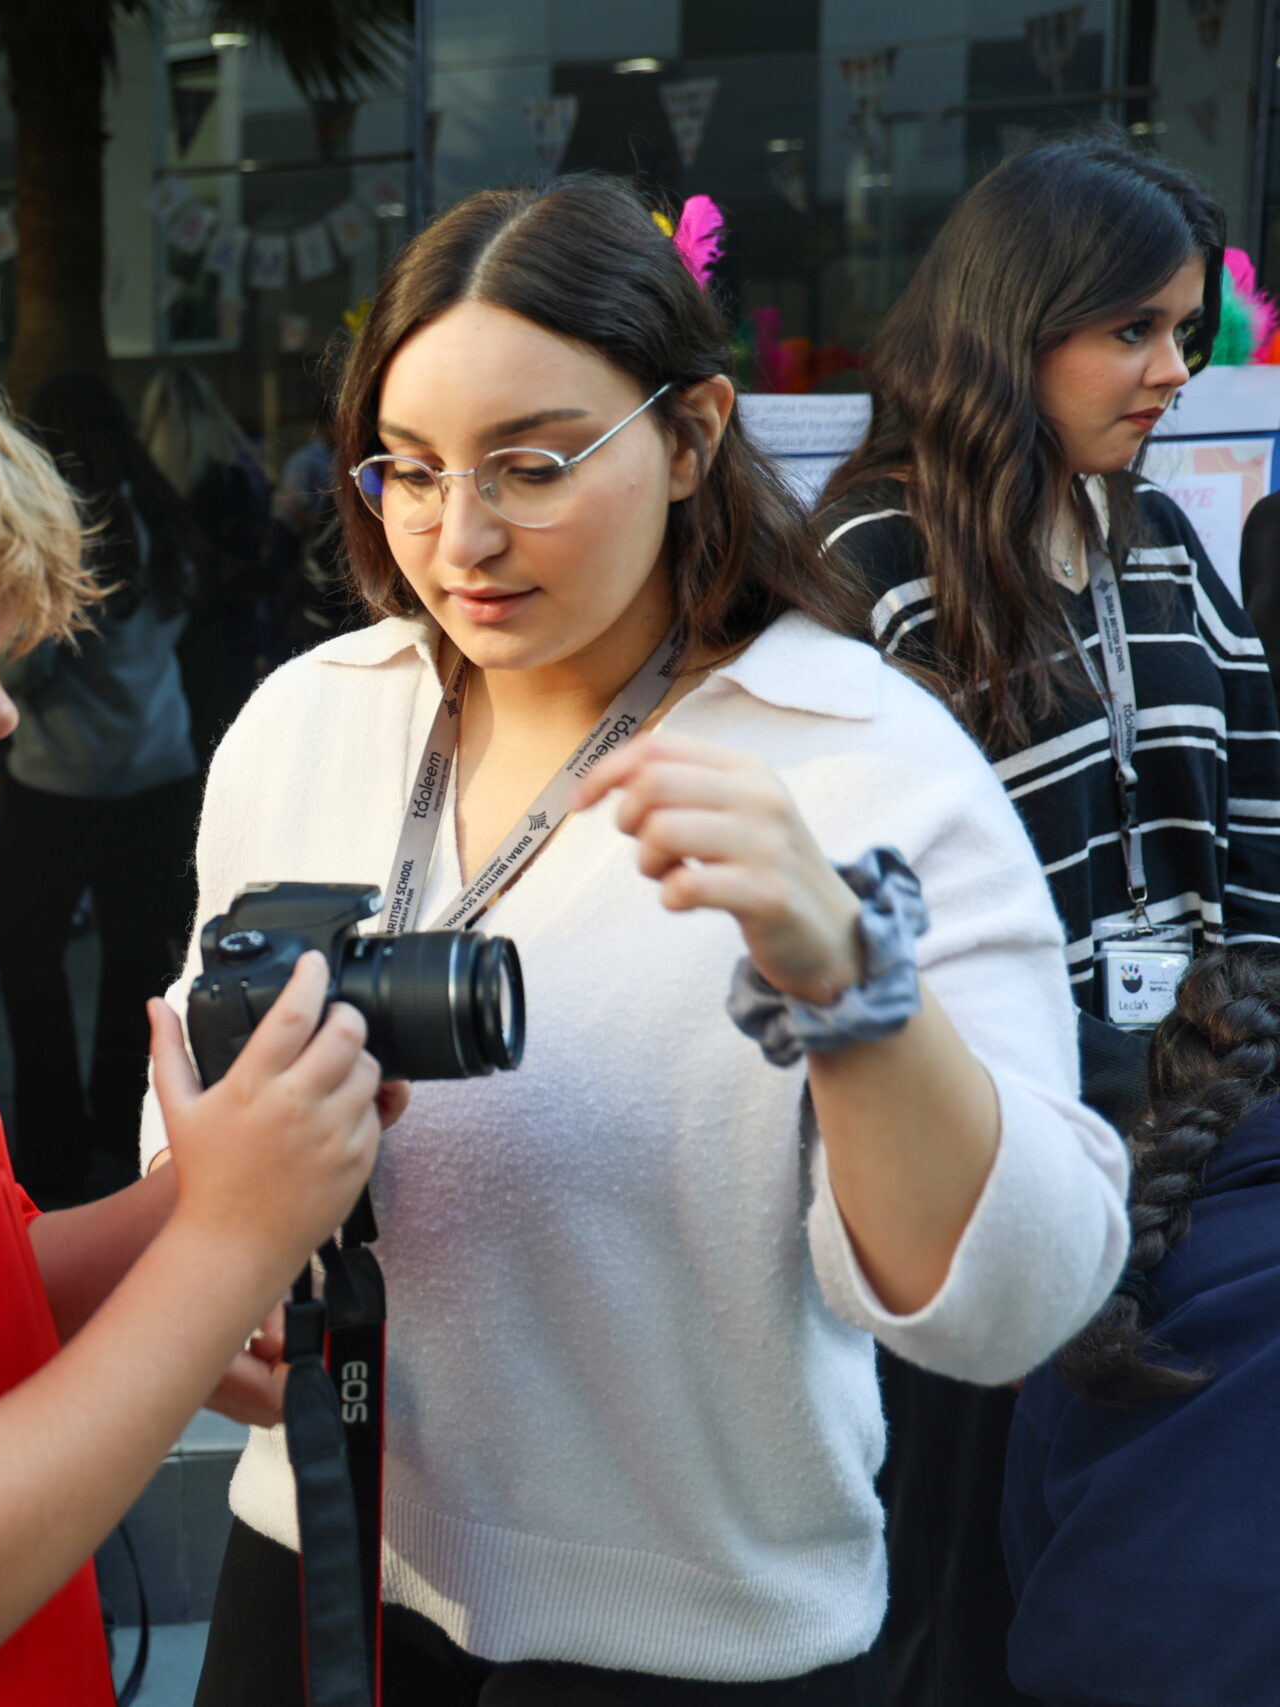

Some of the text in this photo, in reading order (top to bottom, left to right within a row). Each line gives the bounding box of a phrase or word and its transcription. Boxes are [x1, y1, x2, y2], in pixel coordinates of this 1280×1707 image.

[396, 859, 414, 896] SCHOOL
[443, 835, 533, 928] DUBAI BRITISH SCHOOL
[342, 1360, 368, 1423] EOS
